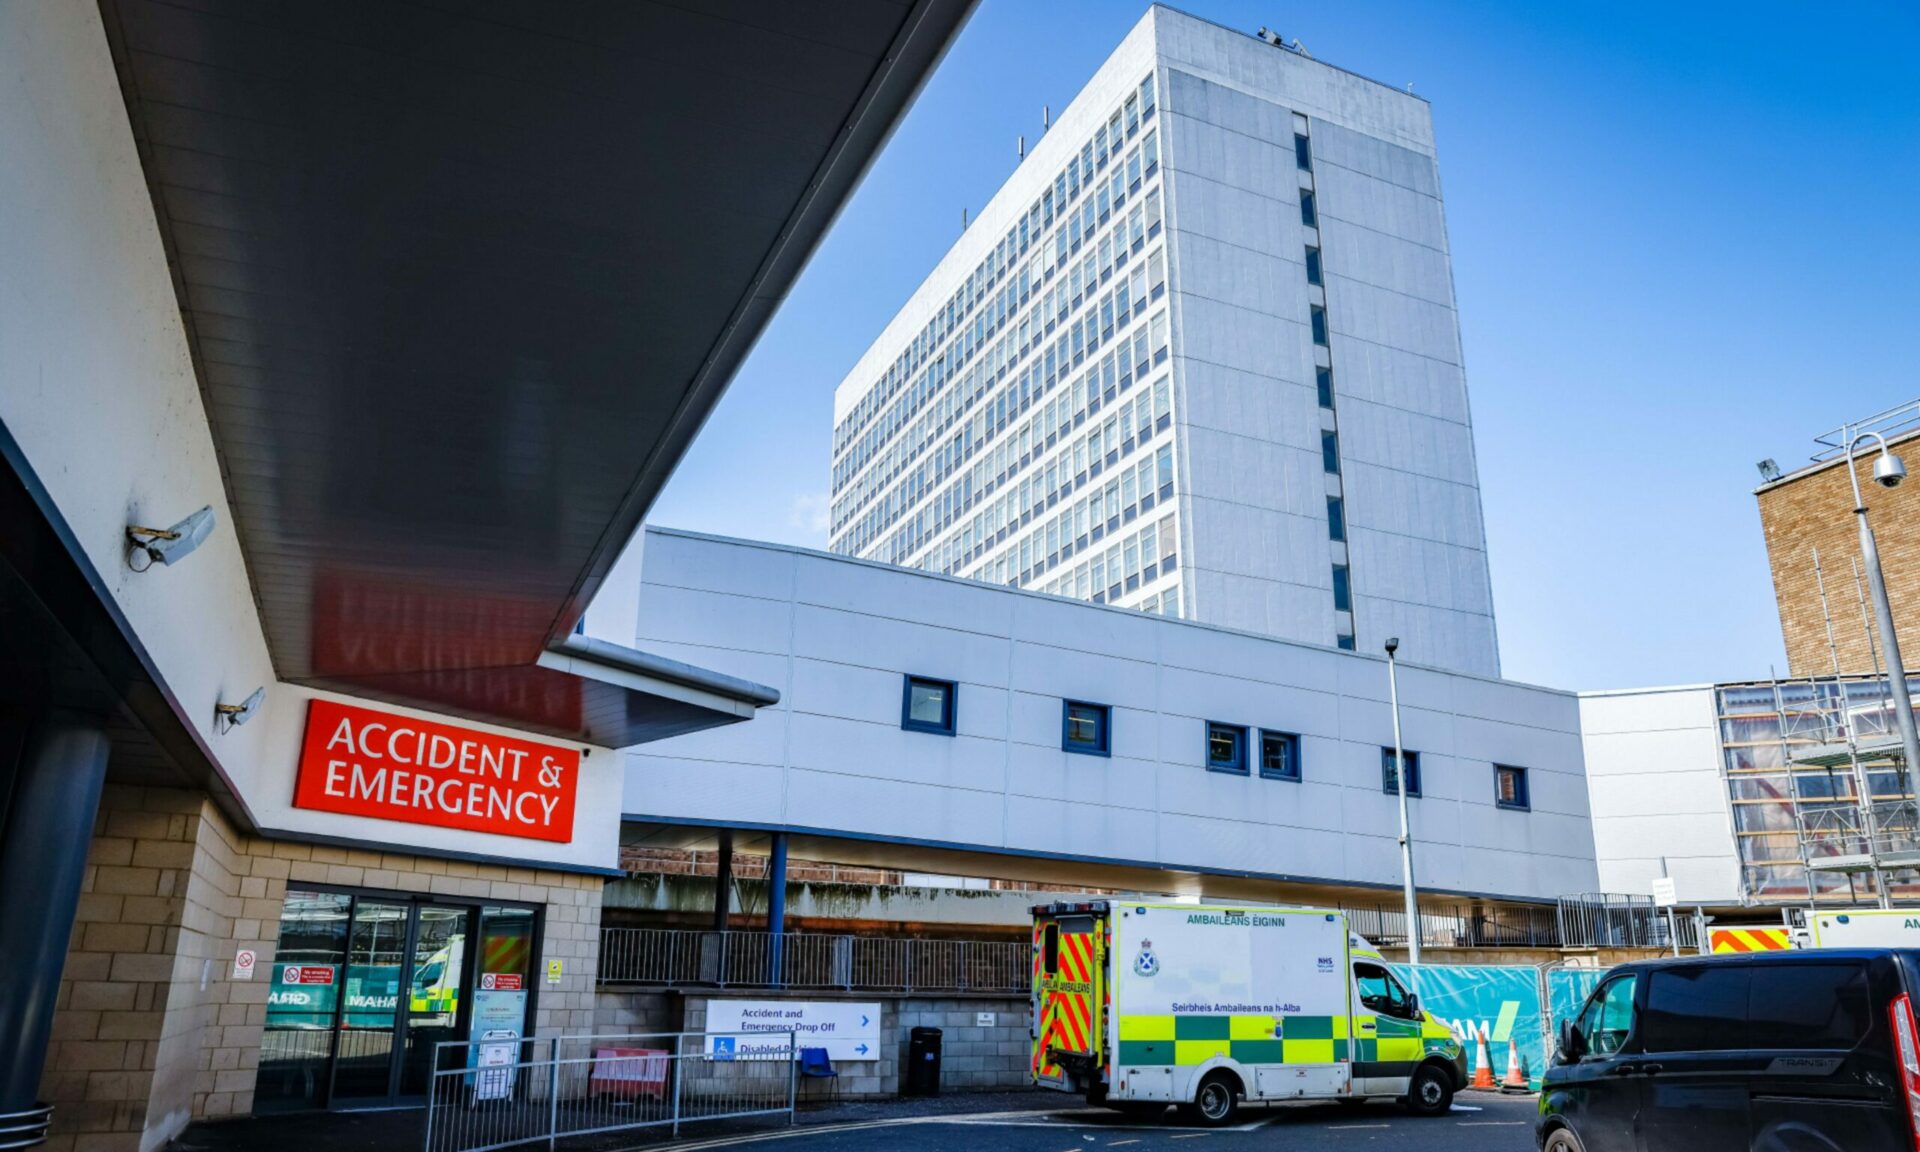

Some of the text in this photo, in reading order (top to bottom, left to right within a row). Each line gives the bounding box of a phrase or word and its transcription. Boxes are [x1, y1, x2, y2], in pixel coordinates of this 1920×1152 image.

[326, 717, 564, 789] ACCIDENT &
[324, 759, 560, 827] EMERGENCY
[1186, 914, 1250, 926] AMBAILEANS
[1171, 1002, 1301, 1013] Seirbheis Ambaileans na h-Alba
[741, 1009, 803, 1018] Accident and
[741, 1022, 835, 1033] Emergency Drop Off
[740, 1044, 782, 1054] Disabled
[1779, 1058, 1836, 1068] TRANSIT
